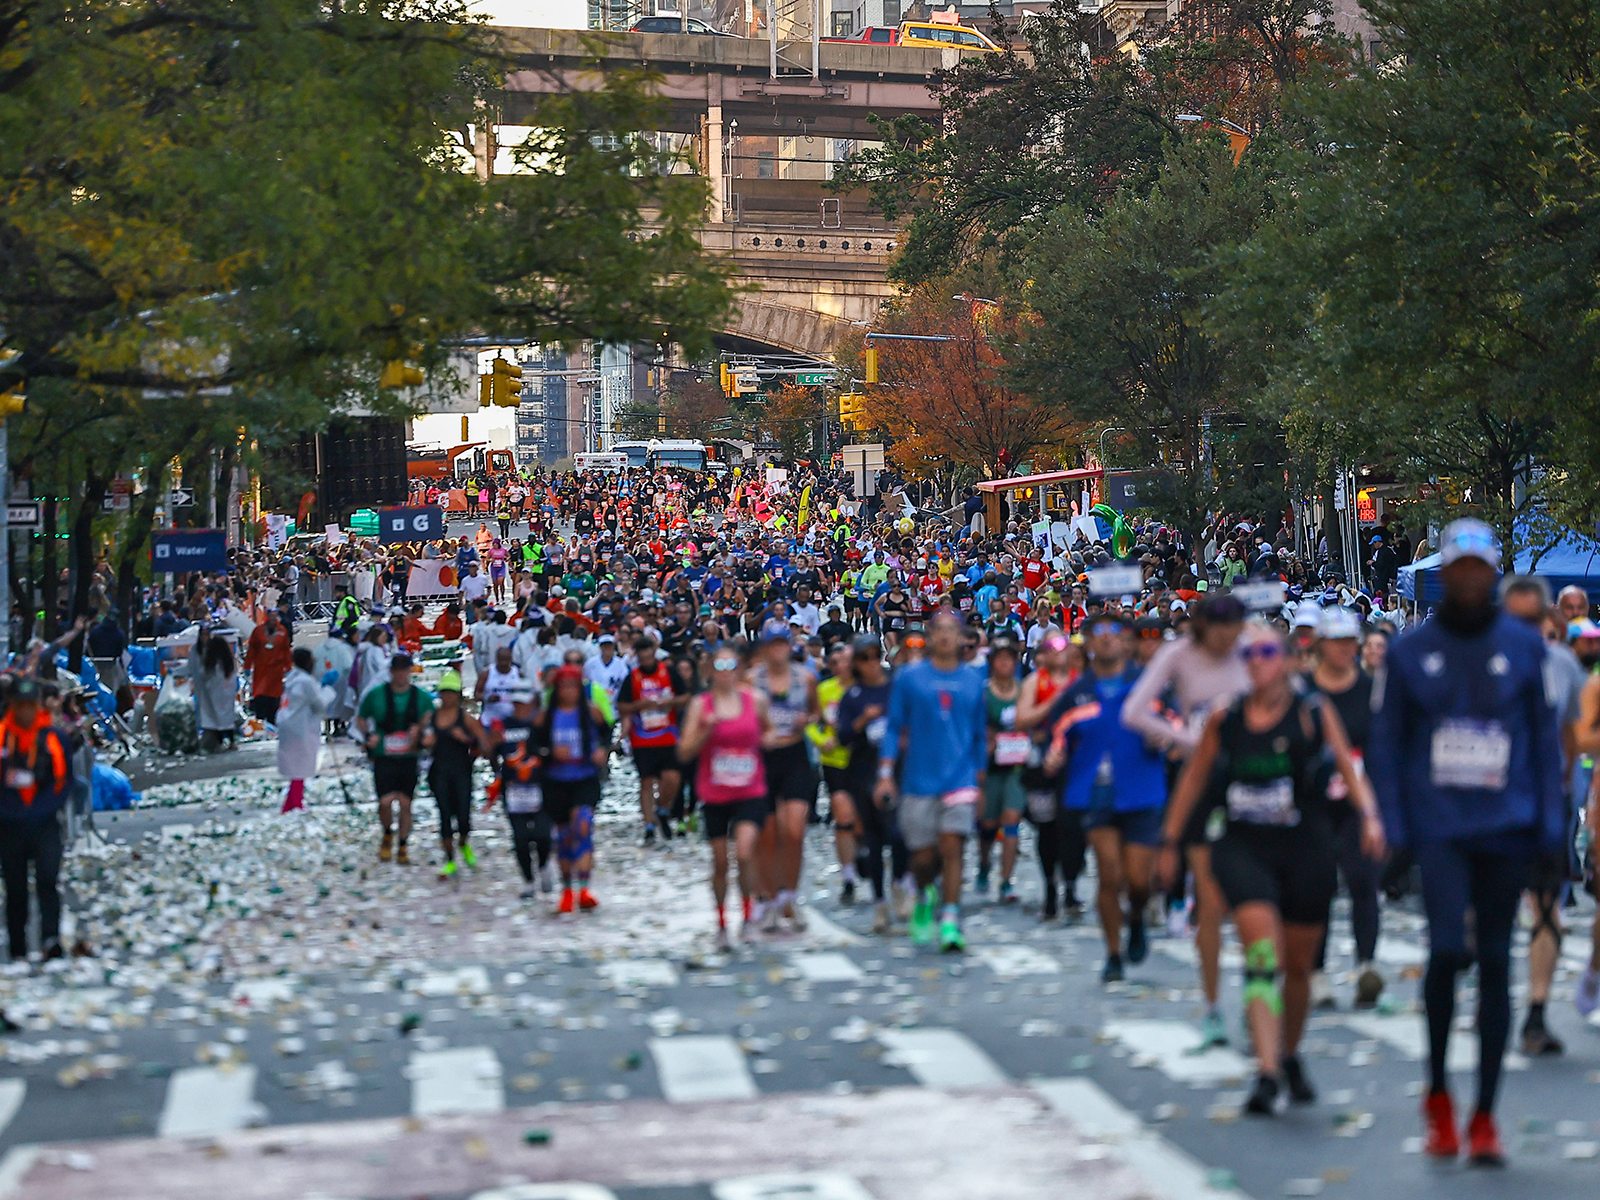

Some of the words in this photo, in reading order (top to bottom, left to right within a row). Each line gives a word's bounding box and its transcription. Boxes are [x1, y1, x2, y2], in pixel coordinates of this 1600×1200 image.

[805, 375, 811, 383] E
[1357, 498, 1372, 509] PEN
[1360, 509, 1376, 520] HRS
[412, 514, 429, 532] G
[175, 546, 207, 556] Water
